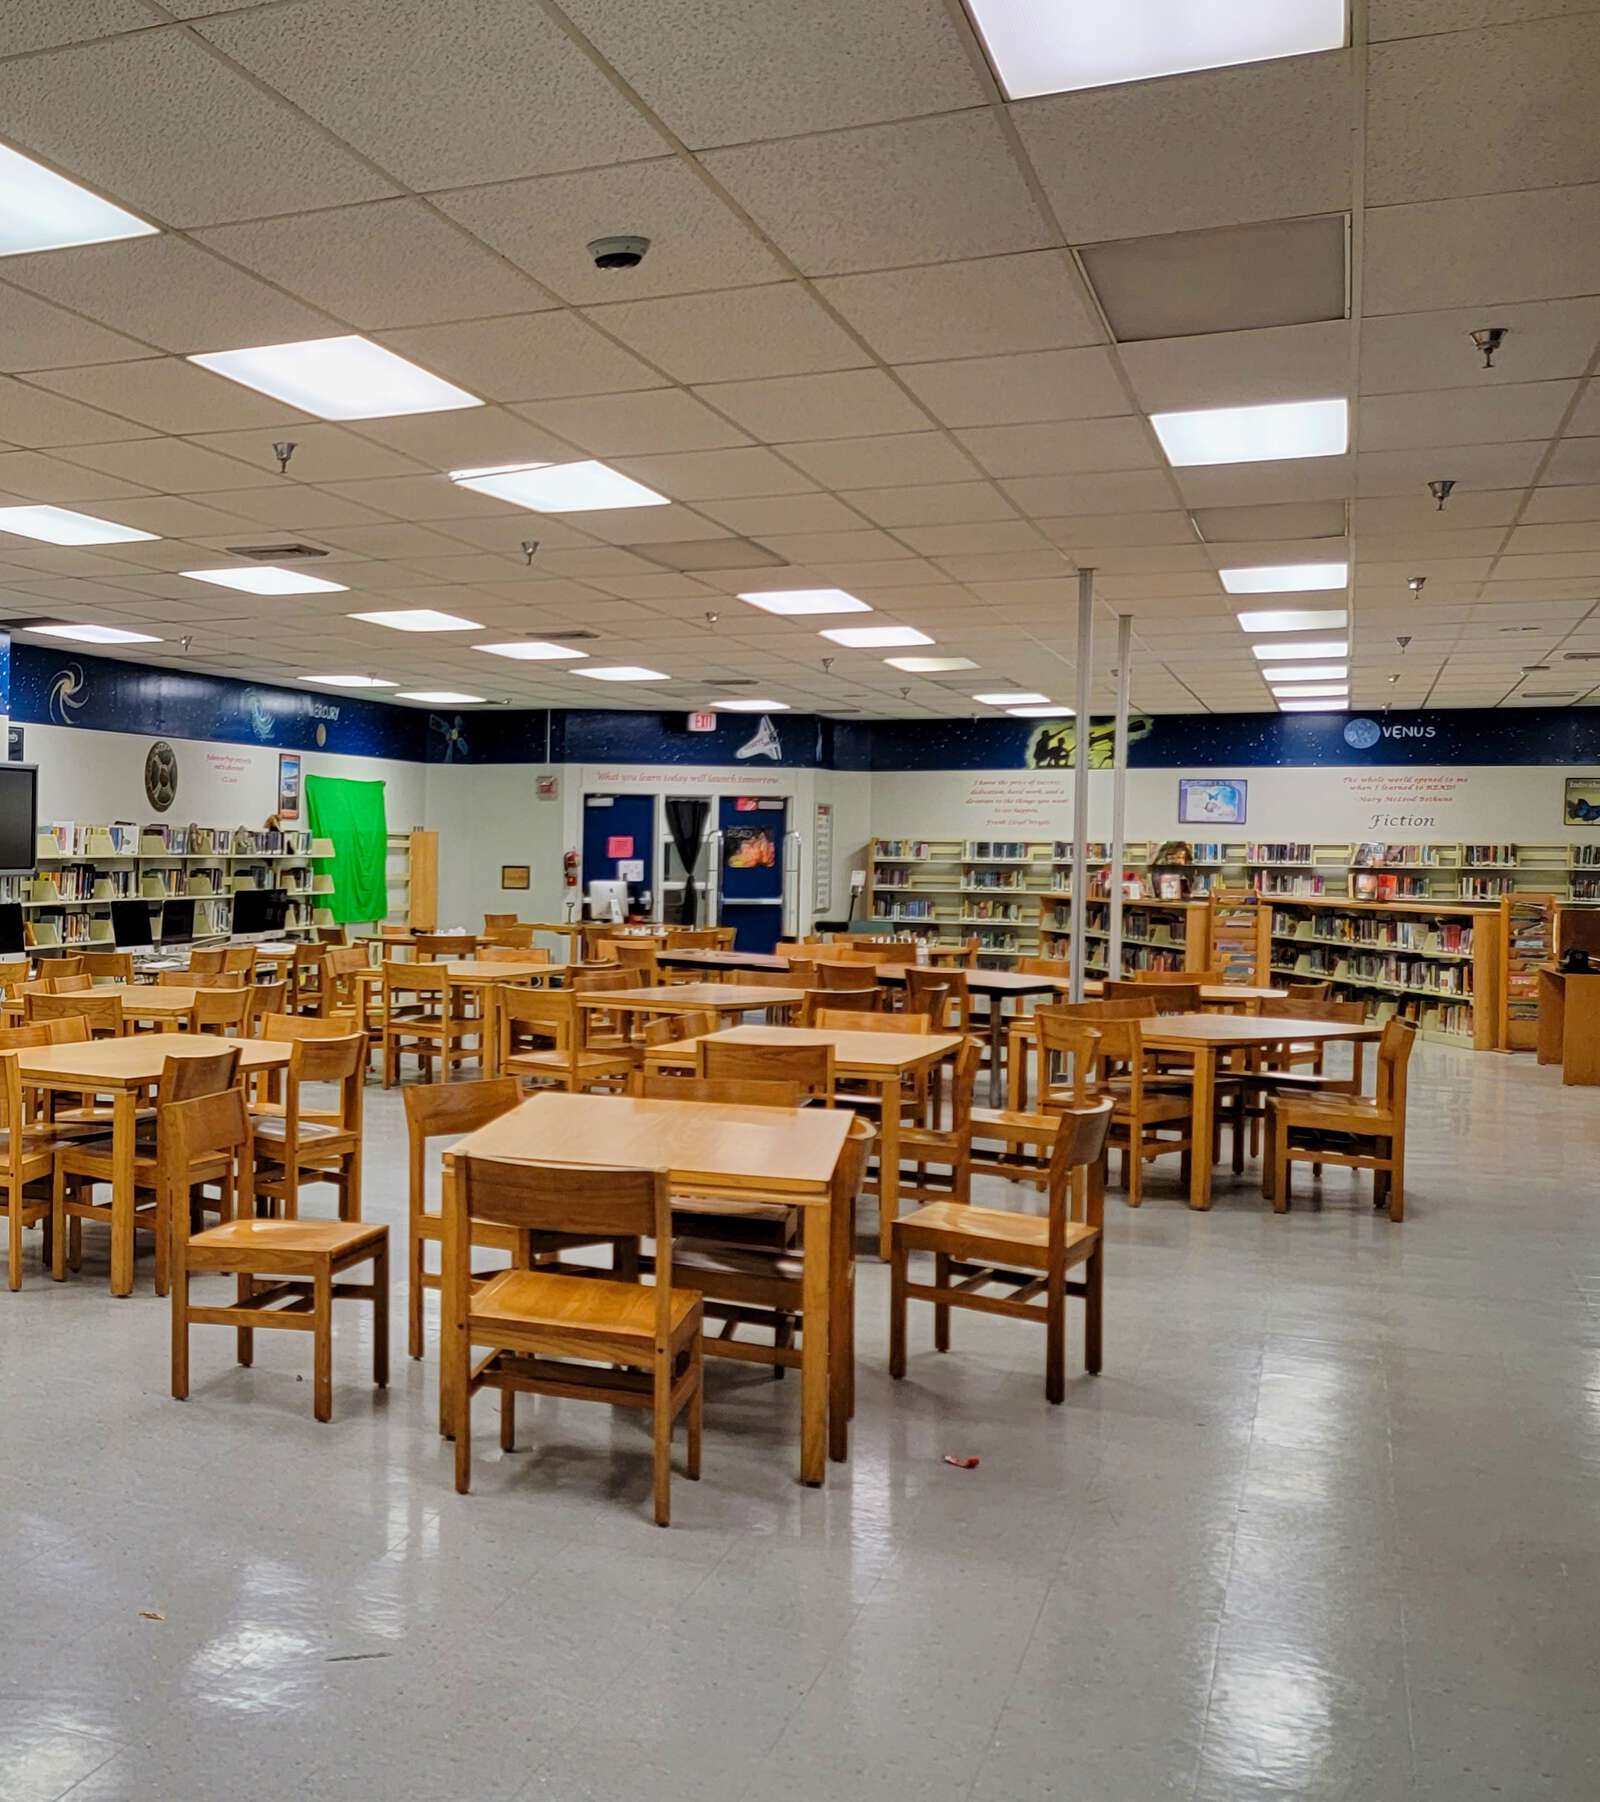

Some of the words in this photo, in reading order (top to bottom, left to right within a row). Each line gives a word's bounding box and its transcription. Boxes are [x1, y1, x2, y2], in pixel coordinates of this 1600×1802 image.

[695, 714, 713, 729] EXIT
[1381, 725, 1437, 739] VENUS
[1367, 813, 1436, 830] Fiction
